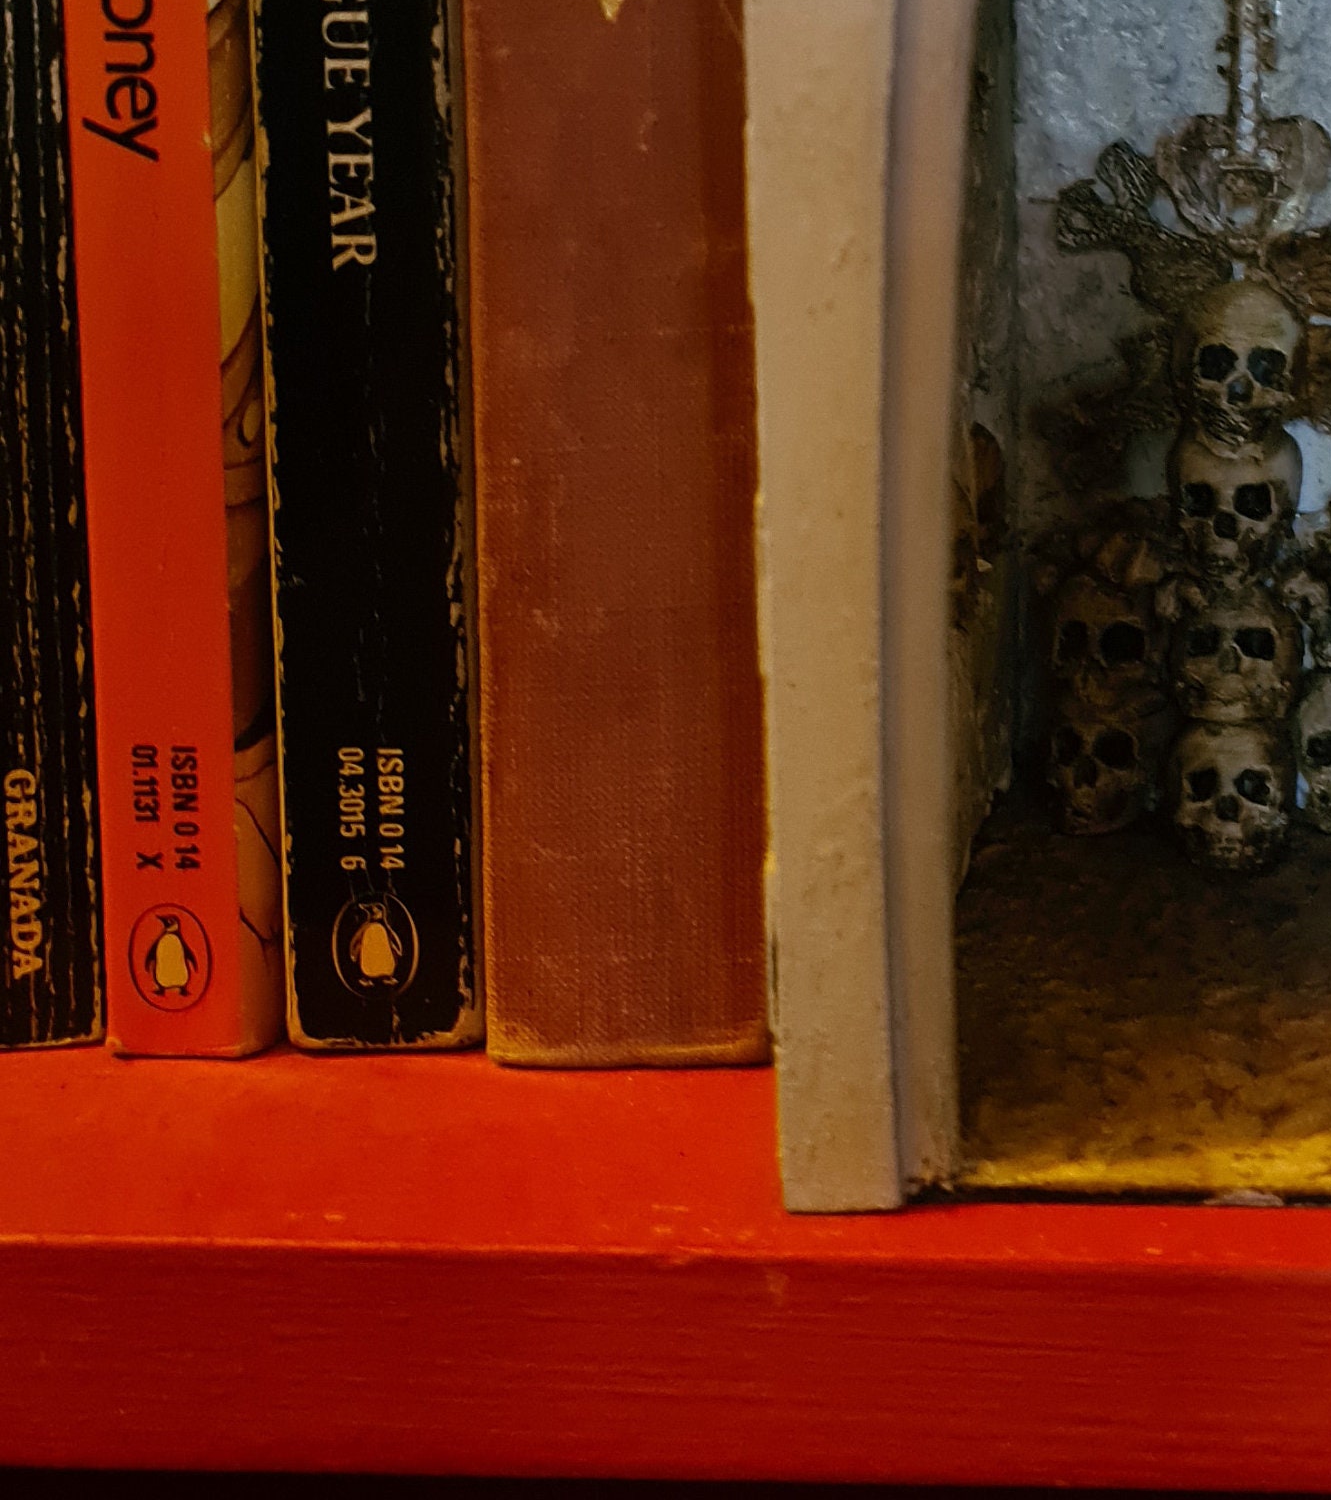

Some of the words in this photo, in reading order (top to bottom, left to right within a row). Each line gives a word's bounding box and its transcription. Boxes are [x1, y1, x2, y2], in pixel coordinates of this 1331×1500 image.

[325, 105, 378, 272] YEAR
[171, 744, 200, 813] ISBN
[376, 747, 406, 816] ISBN
[173, 821, 201, 838] 0
[378, 822, 405, 838] 0
[135, 851, 165, 873] X
[174, 843, 202, 872] 14
[339, 855, 367, 871] 6
[378, 843, 406, 870] 14
[3, 767, 45, 980] GRANADA
